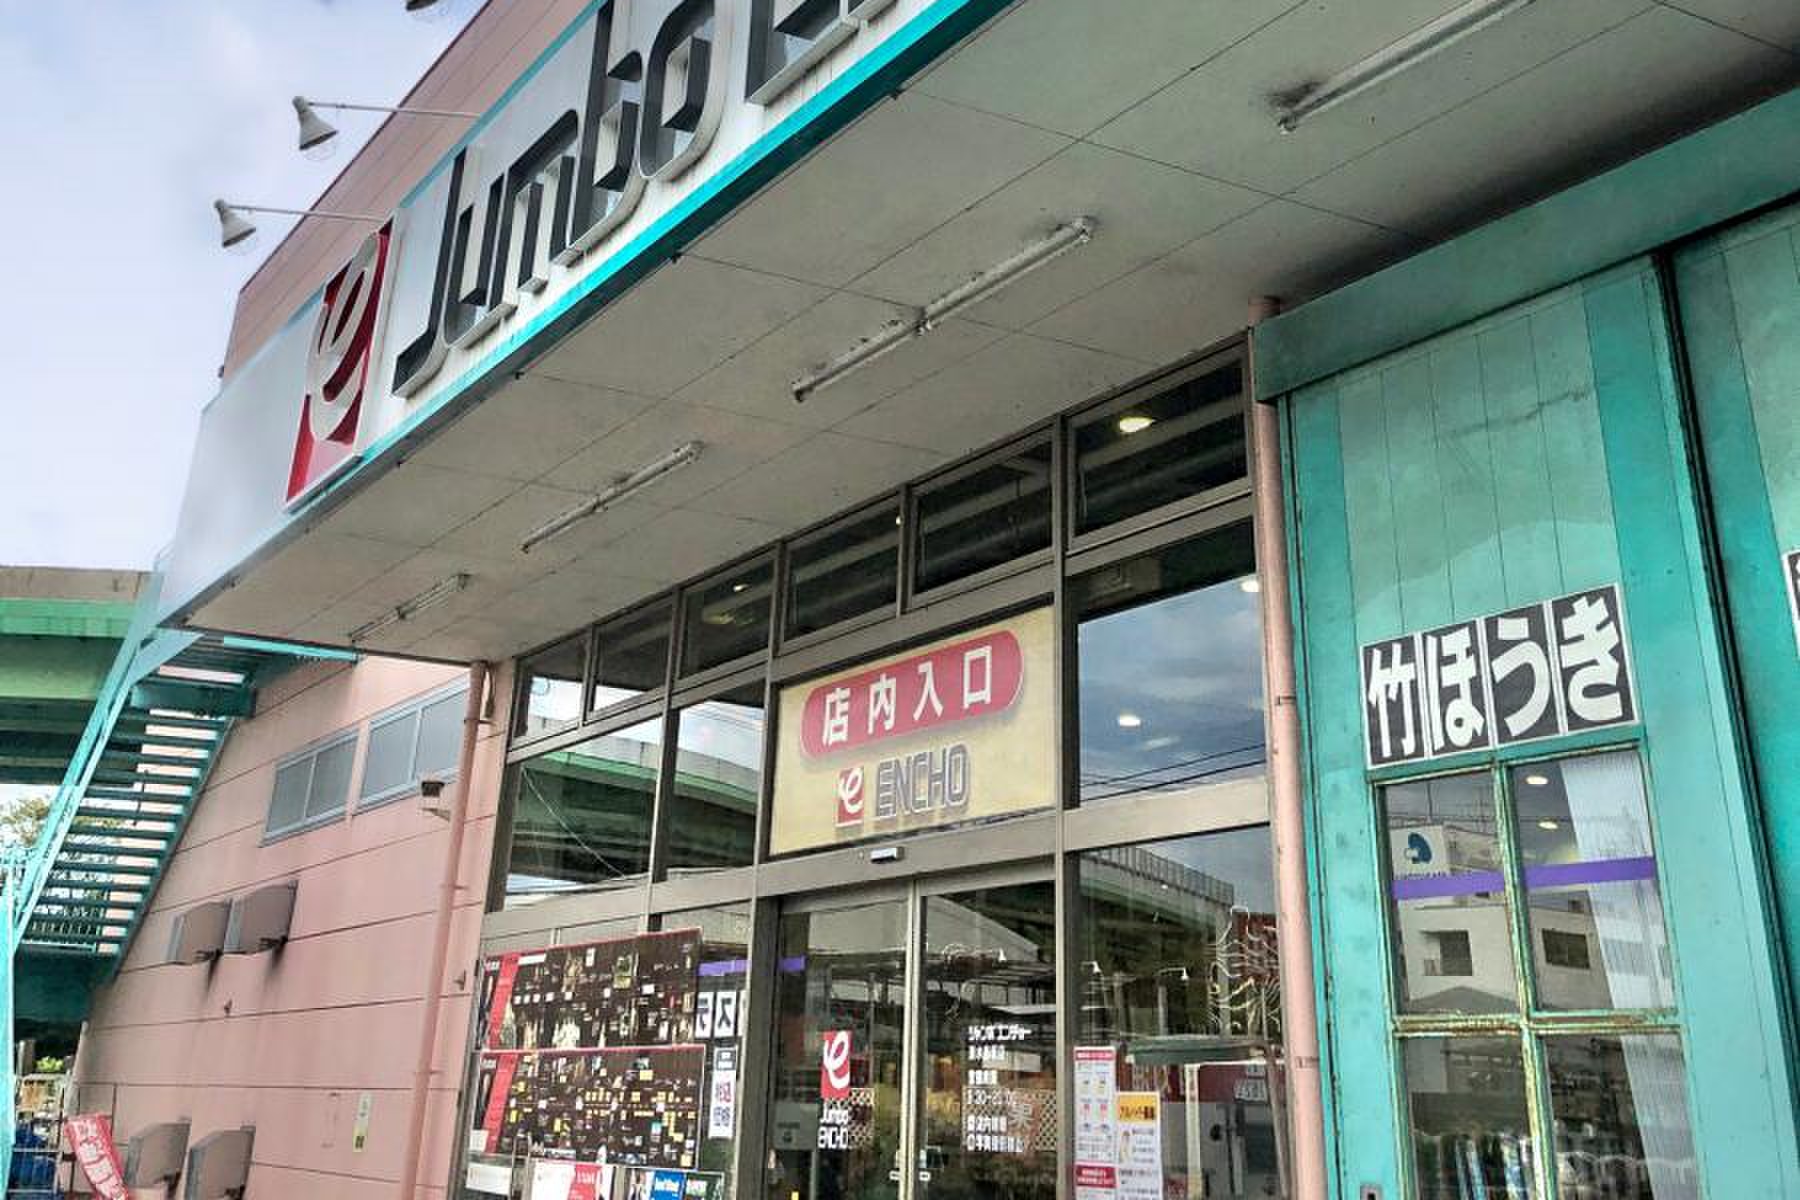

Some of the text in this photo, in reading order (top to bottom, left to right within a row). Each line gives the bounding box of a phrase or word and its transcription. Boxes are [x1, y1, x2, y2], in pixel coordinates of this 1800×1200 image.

[822, 645, 993, 747] 店内入口
[1367, 595, 1625, 758] 竹ほうき
[876, 744, 969, 817] ENCHO
